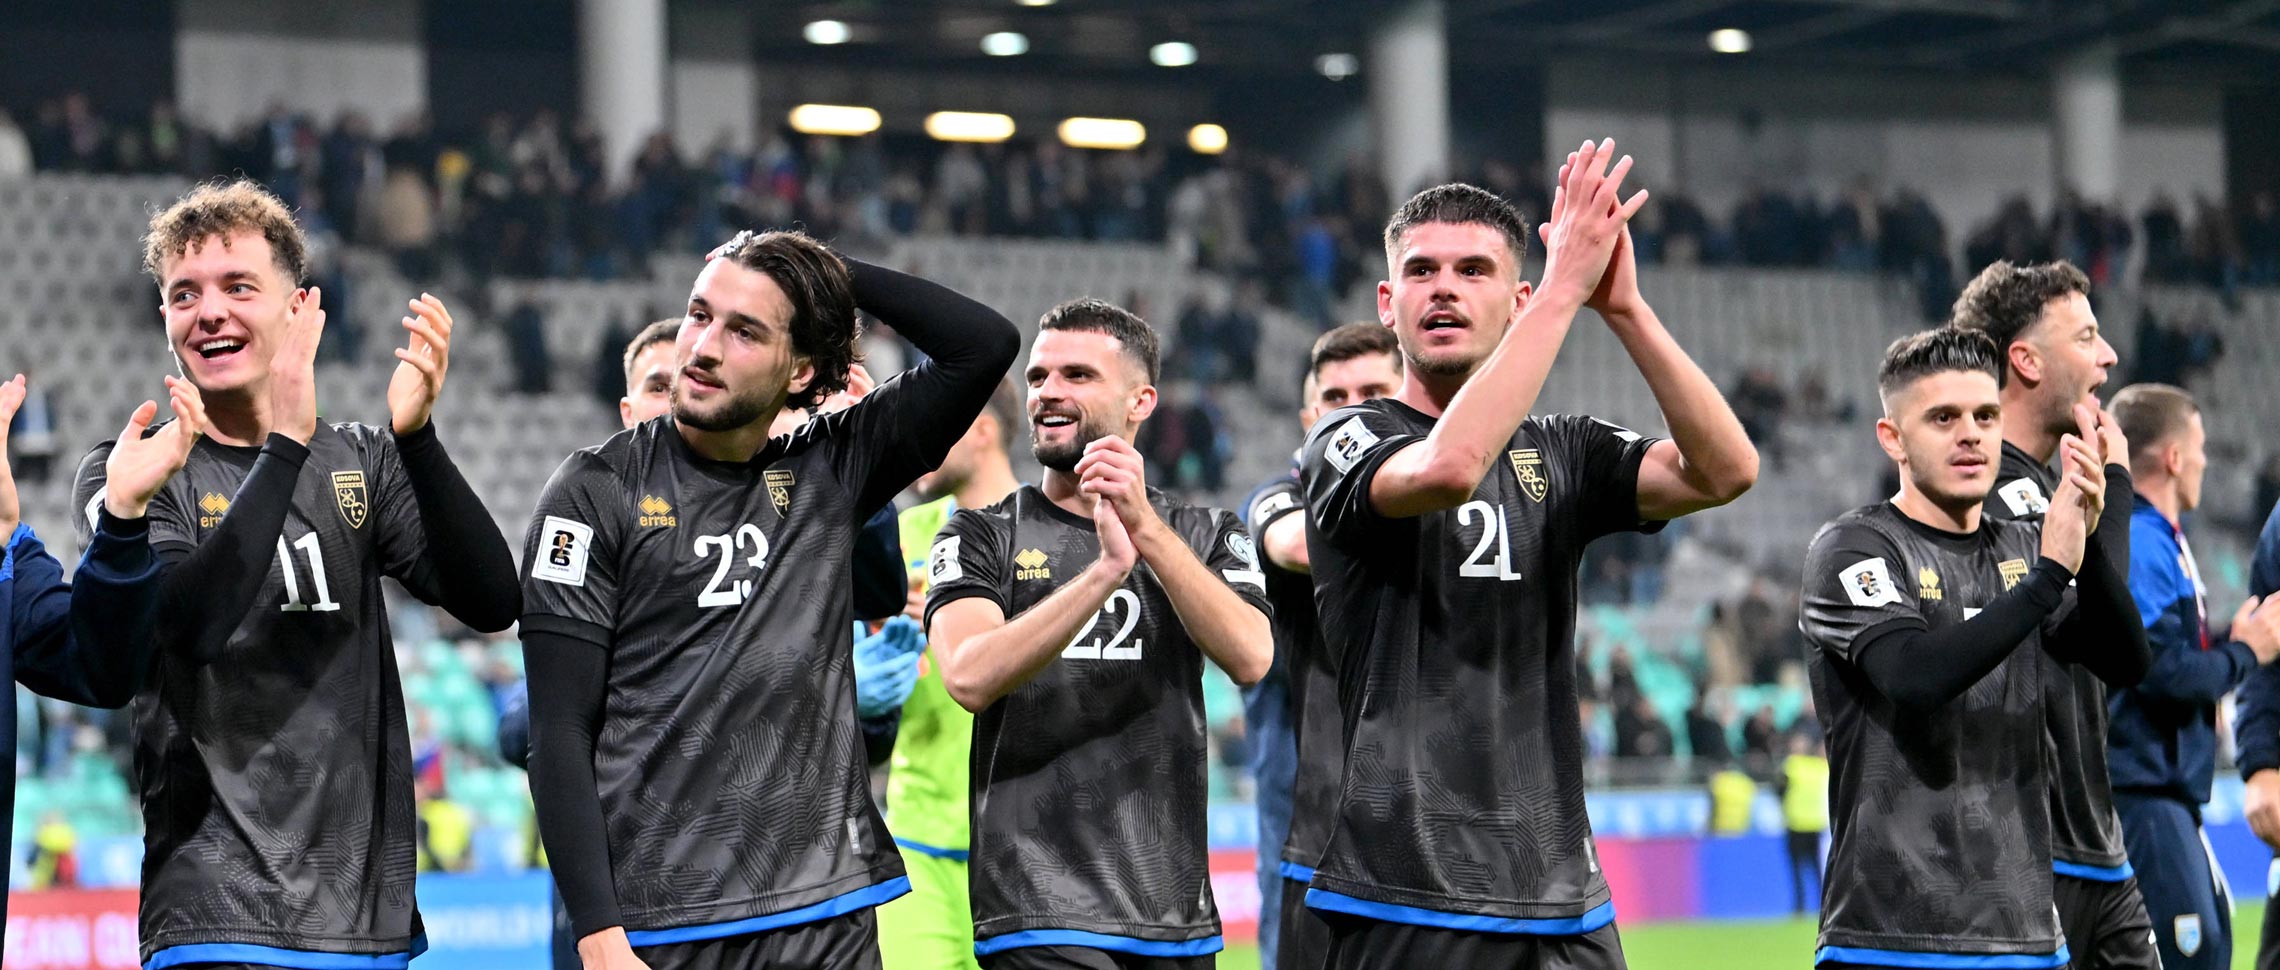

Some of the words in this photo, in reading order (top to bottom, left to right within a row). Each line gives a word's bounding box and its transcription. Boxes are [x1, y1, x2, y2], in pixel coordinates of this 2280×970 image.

[1513, 452, 1539, 460] KOSOVA
[639, 516, 677, 527] errea
[1457, 500, 1522, 581] 21
[276, 531, 341, 612] 11
[693, 523, 769, 608] 23
[1016, 567, 1050, 581] errea
[1061, 588, 1142, 660] 22
